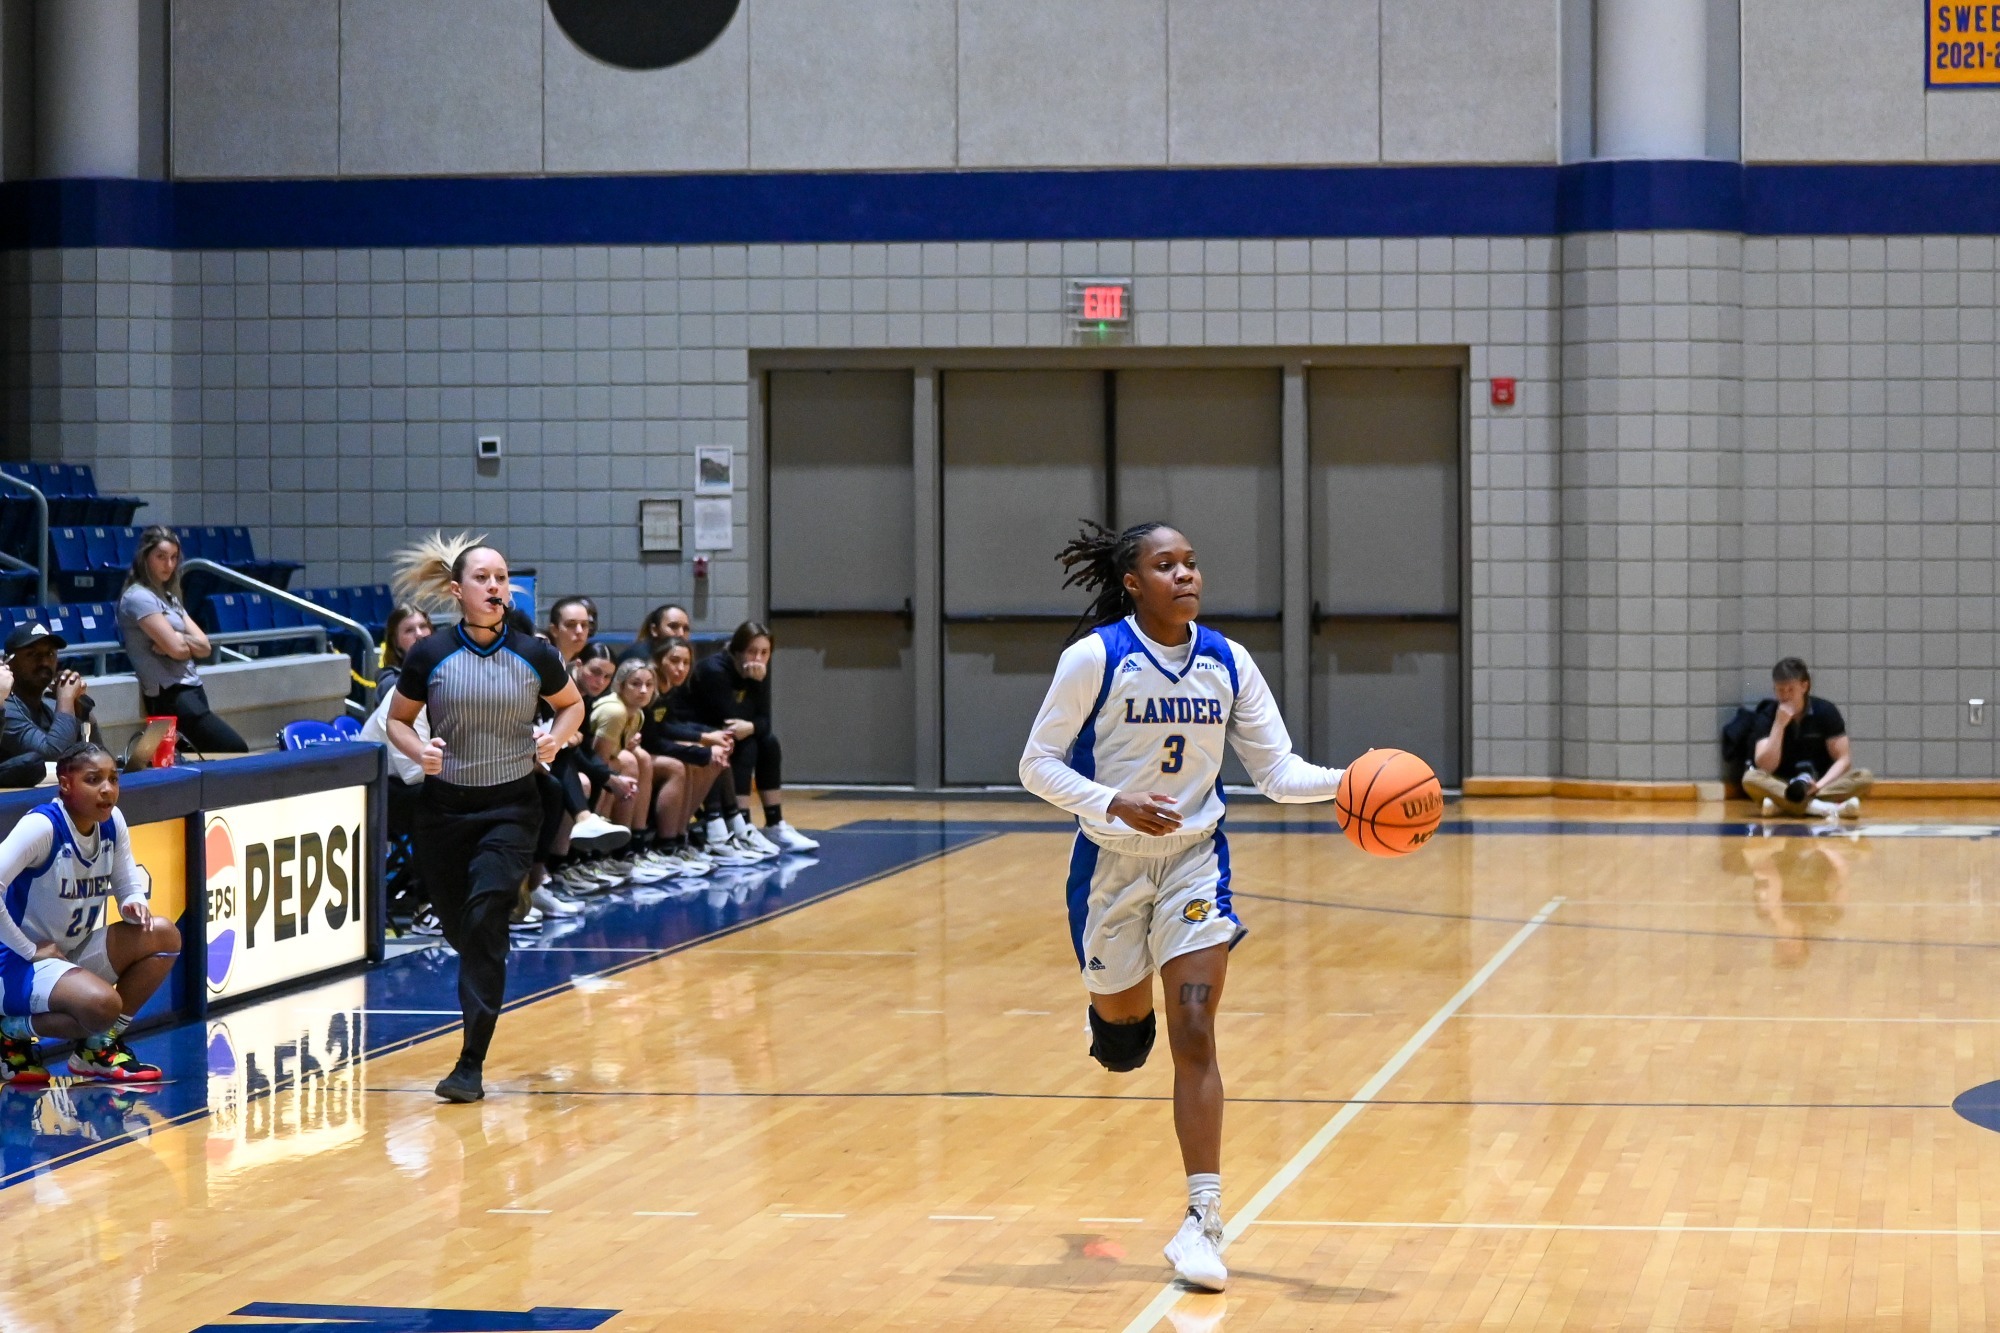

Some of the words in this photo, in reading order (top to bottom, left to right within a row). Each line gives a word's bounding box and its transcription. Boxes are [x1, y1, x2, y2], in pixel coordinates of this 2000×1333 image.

[1084, 286, 1123, 319] EXIT
[1125, 698, 1223, 724] LANDER
[1161, 734, 1186, 774] 3
[245, 823, 361, 950] PEPSI
